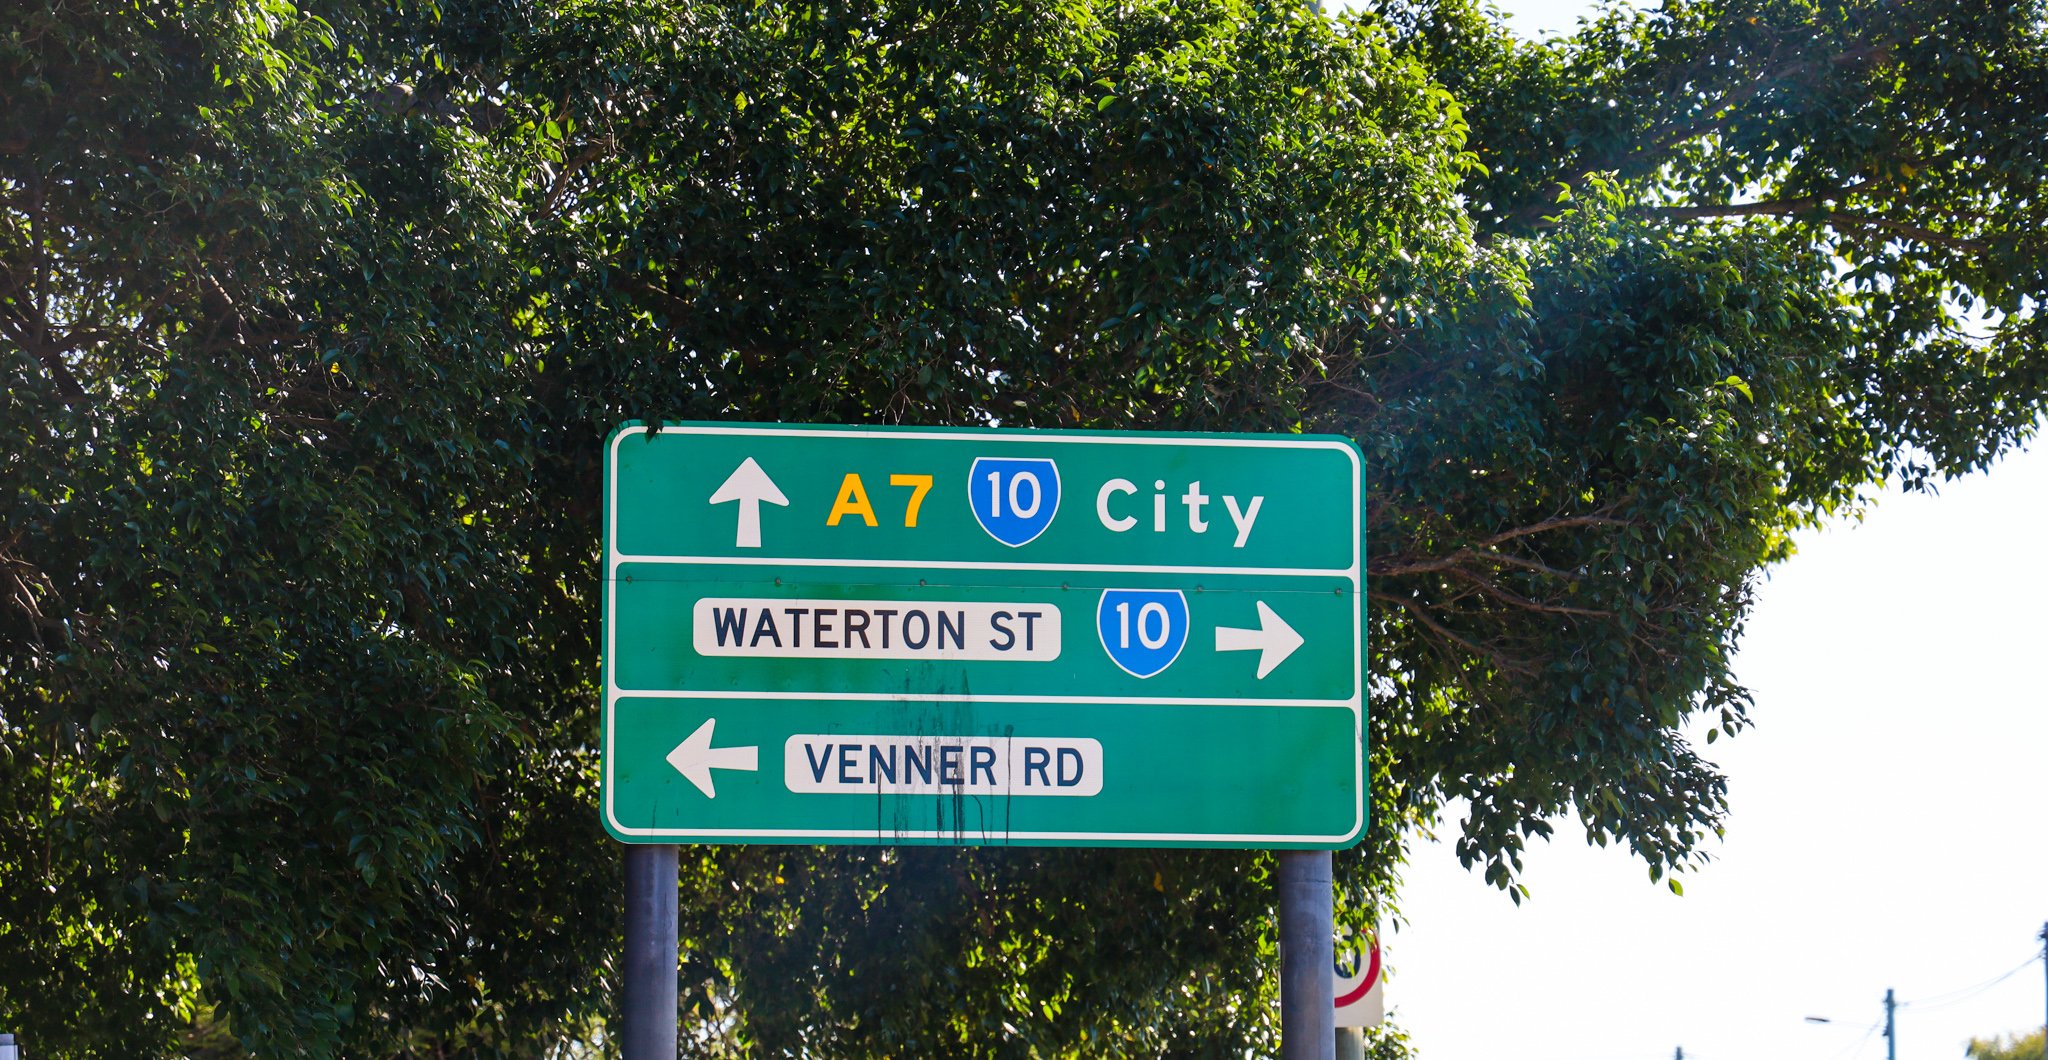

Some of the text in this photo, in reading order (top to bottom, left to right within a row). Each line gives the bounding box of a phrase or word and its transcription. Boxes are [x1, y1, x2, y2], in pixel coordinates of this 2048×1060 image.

[827, 471, 1264, 548] A7 10 City
[713, 602, 1170, 652] WATERTON ST 10
[805, 744, 1084, 788] VENNER RD
